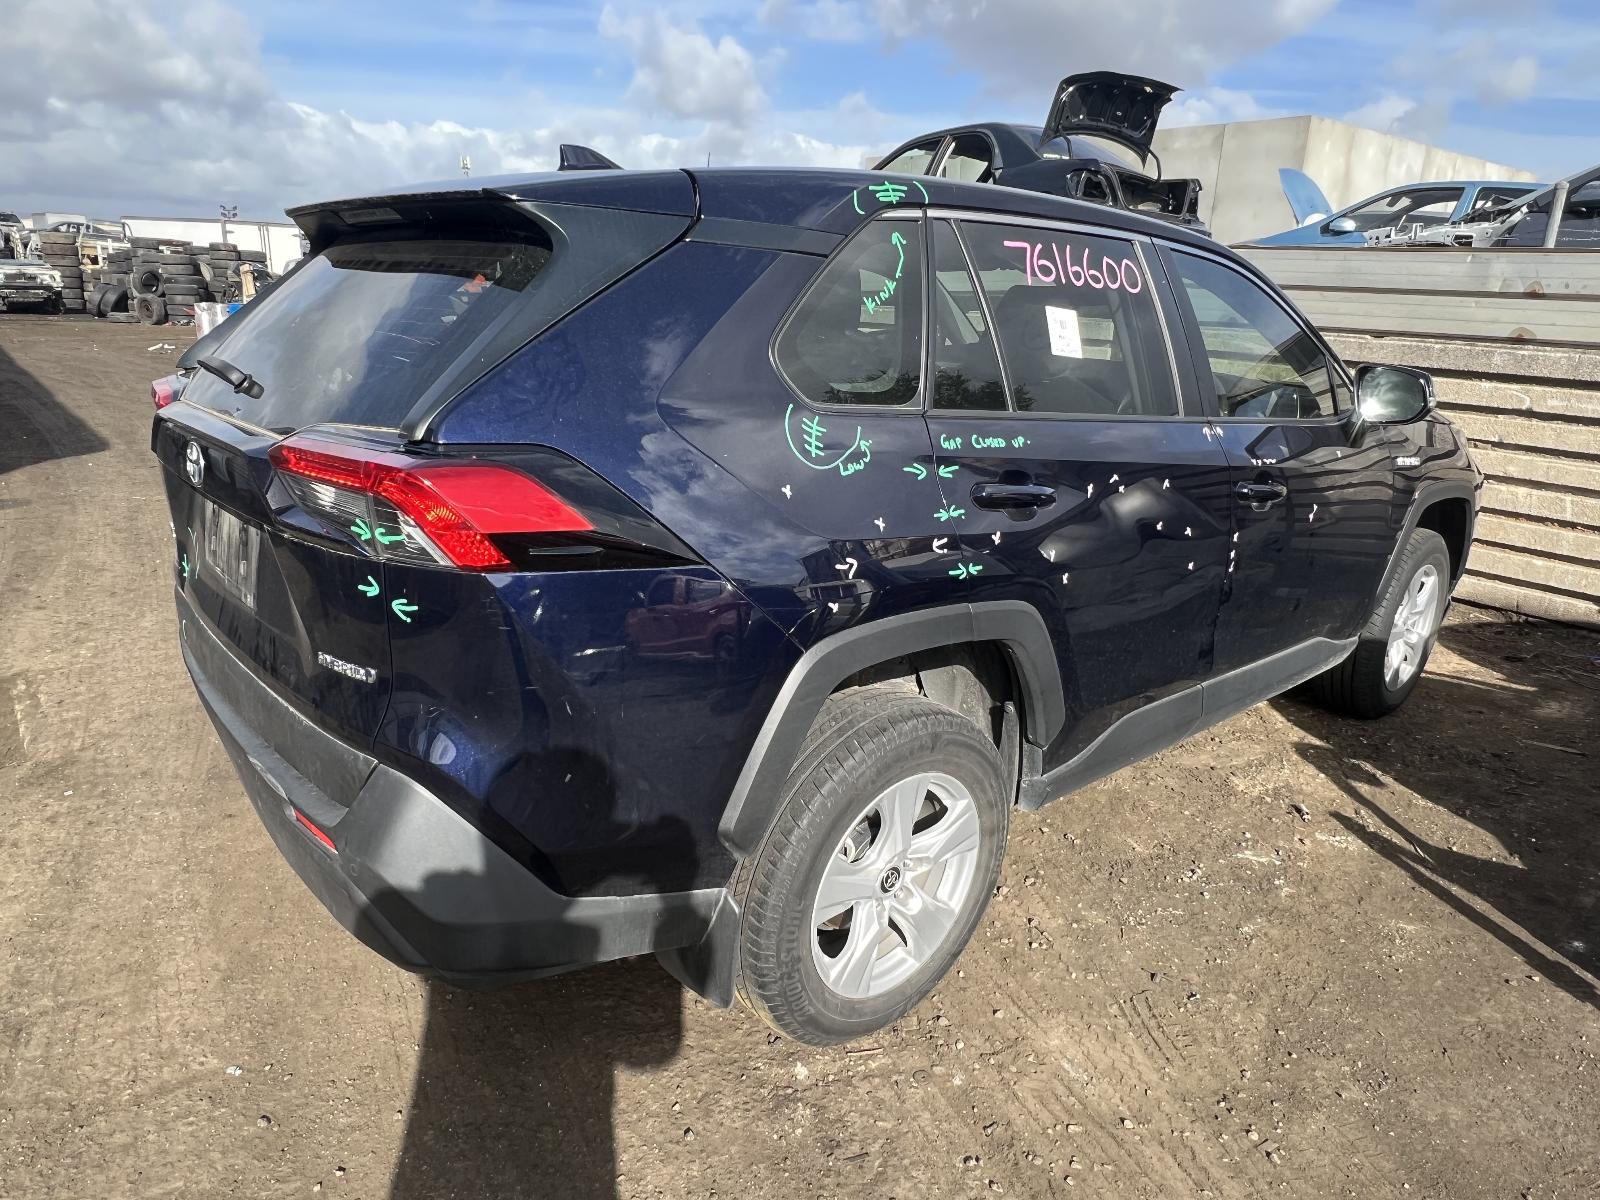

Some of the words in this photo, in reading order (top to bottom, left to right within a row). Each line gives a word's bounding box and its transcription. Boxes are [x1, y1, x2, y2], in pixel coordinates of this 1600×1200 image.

[1003, 240, 1142, 294] 7616600
[863, 279, 897, 315] KINK
[940, 433, 962, 450] GAP
[838, 459, 865, 476] LOW
